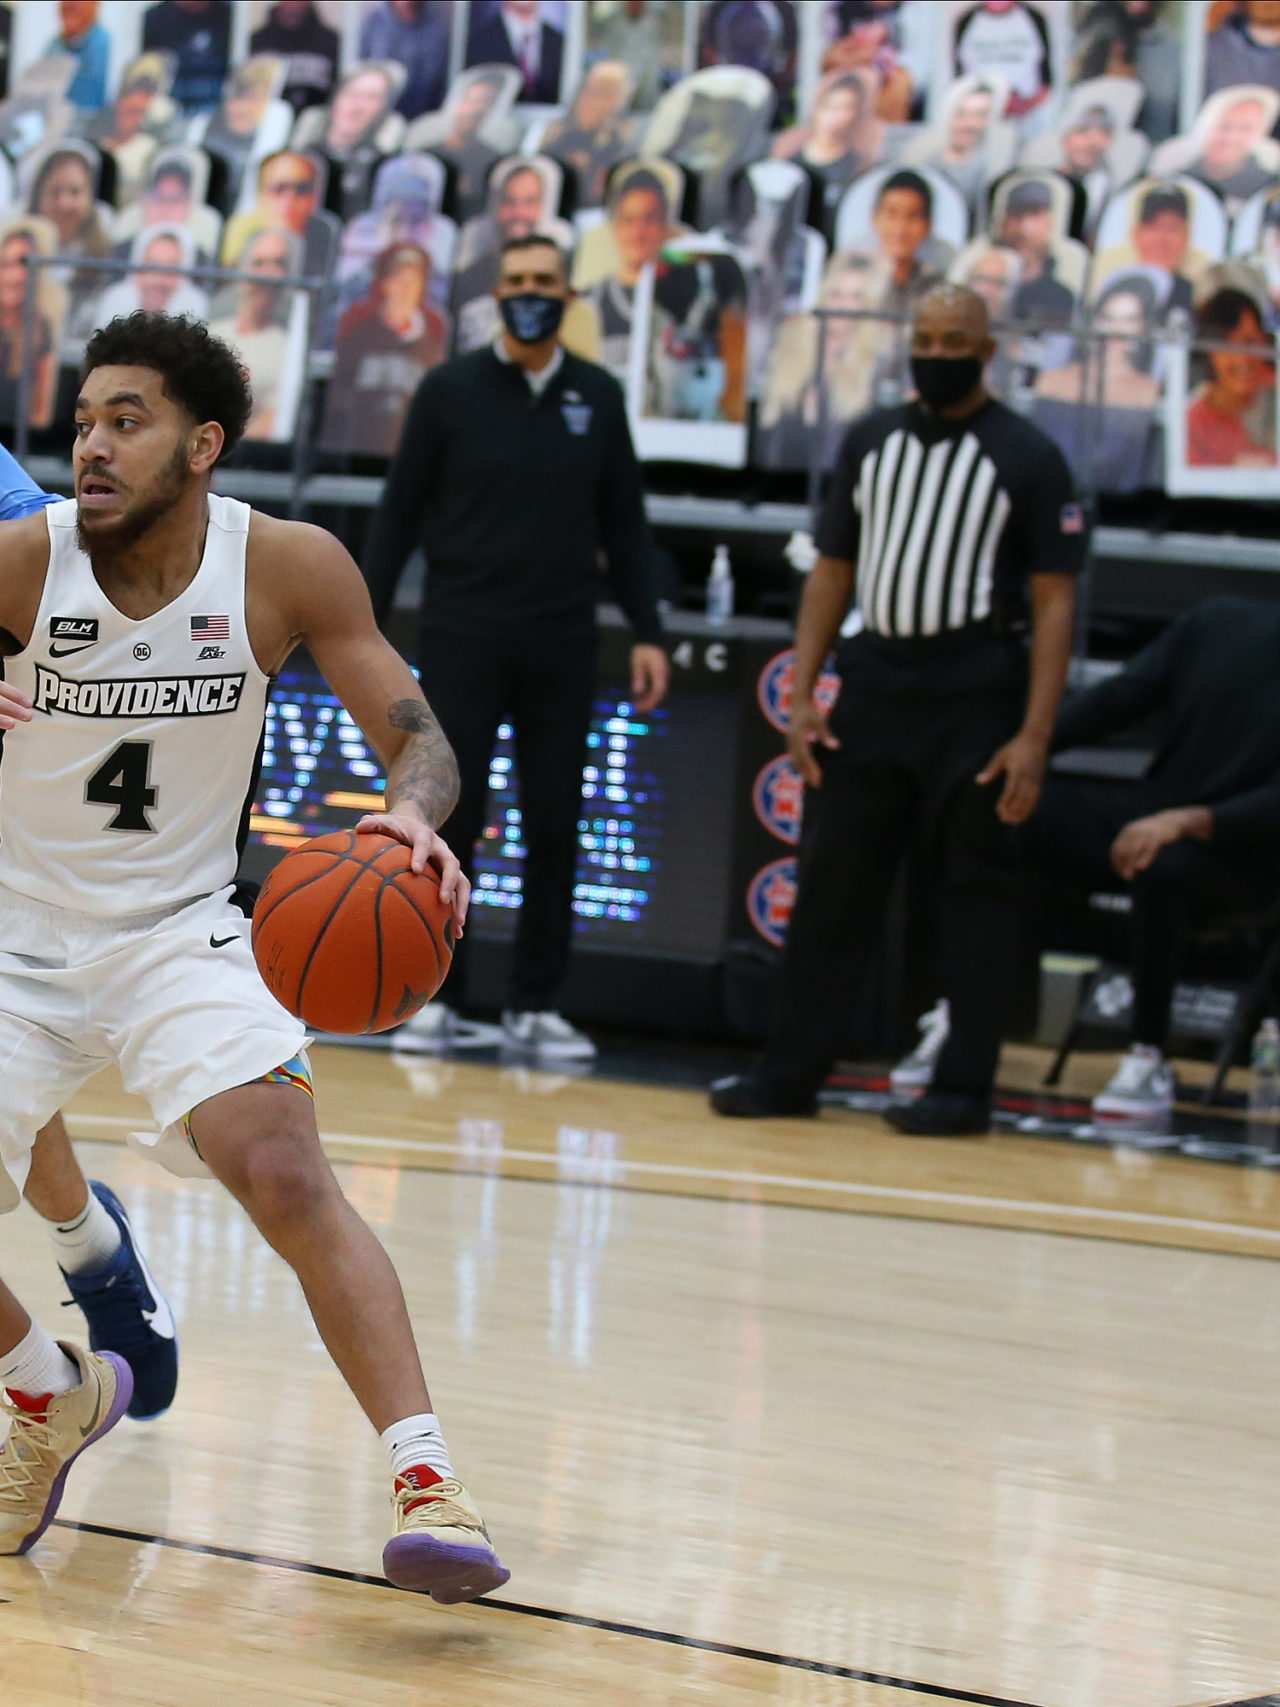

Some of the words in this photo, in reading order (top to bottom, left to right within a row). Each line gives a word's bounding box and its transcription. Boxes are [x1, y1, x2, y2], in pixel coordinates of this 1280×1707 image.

[55, 621, 95, 633] BLM
[135, 646, 149, 657] DG
[34, 664, 246, 718] PROVIDENCE
[83, 738, 160, 834] 4
